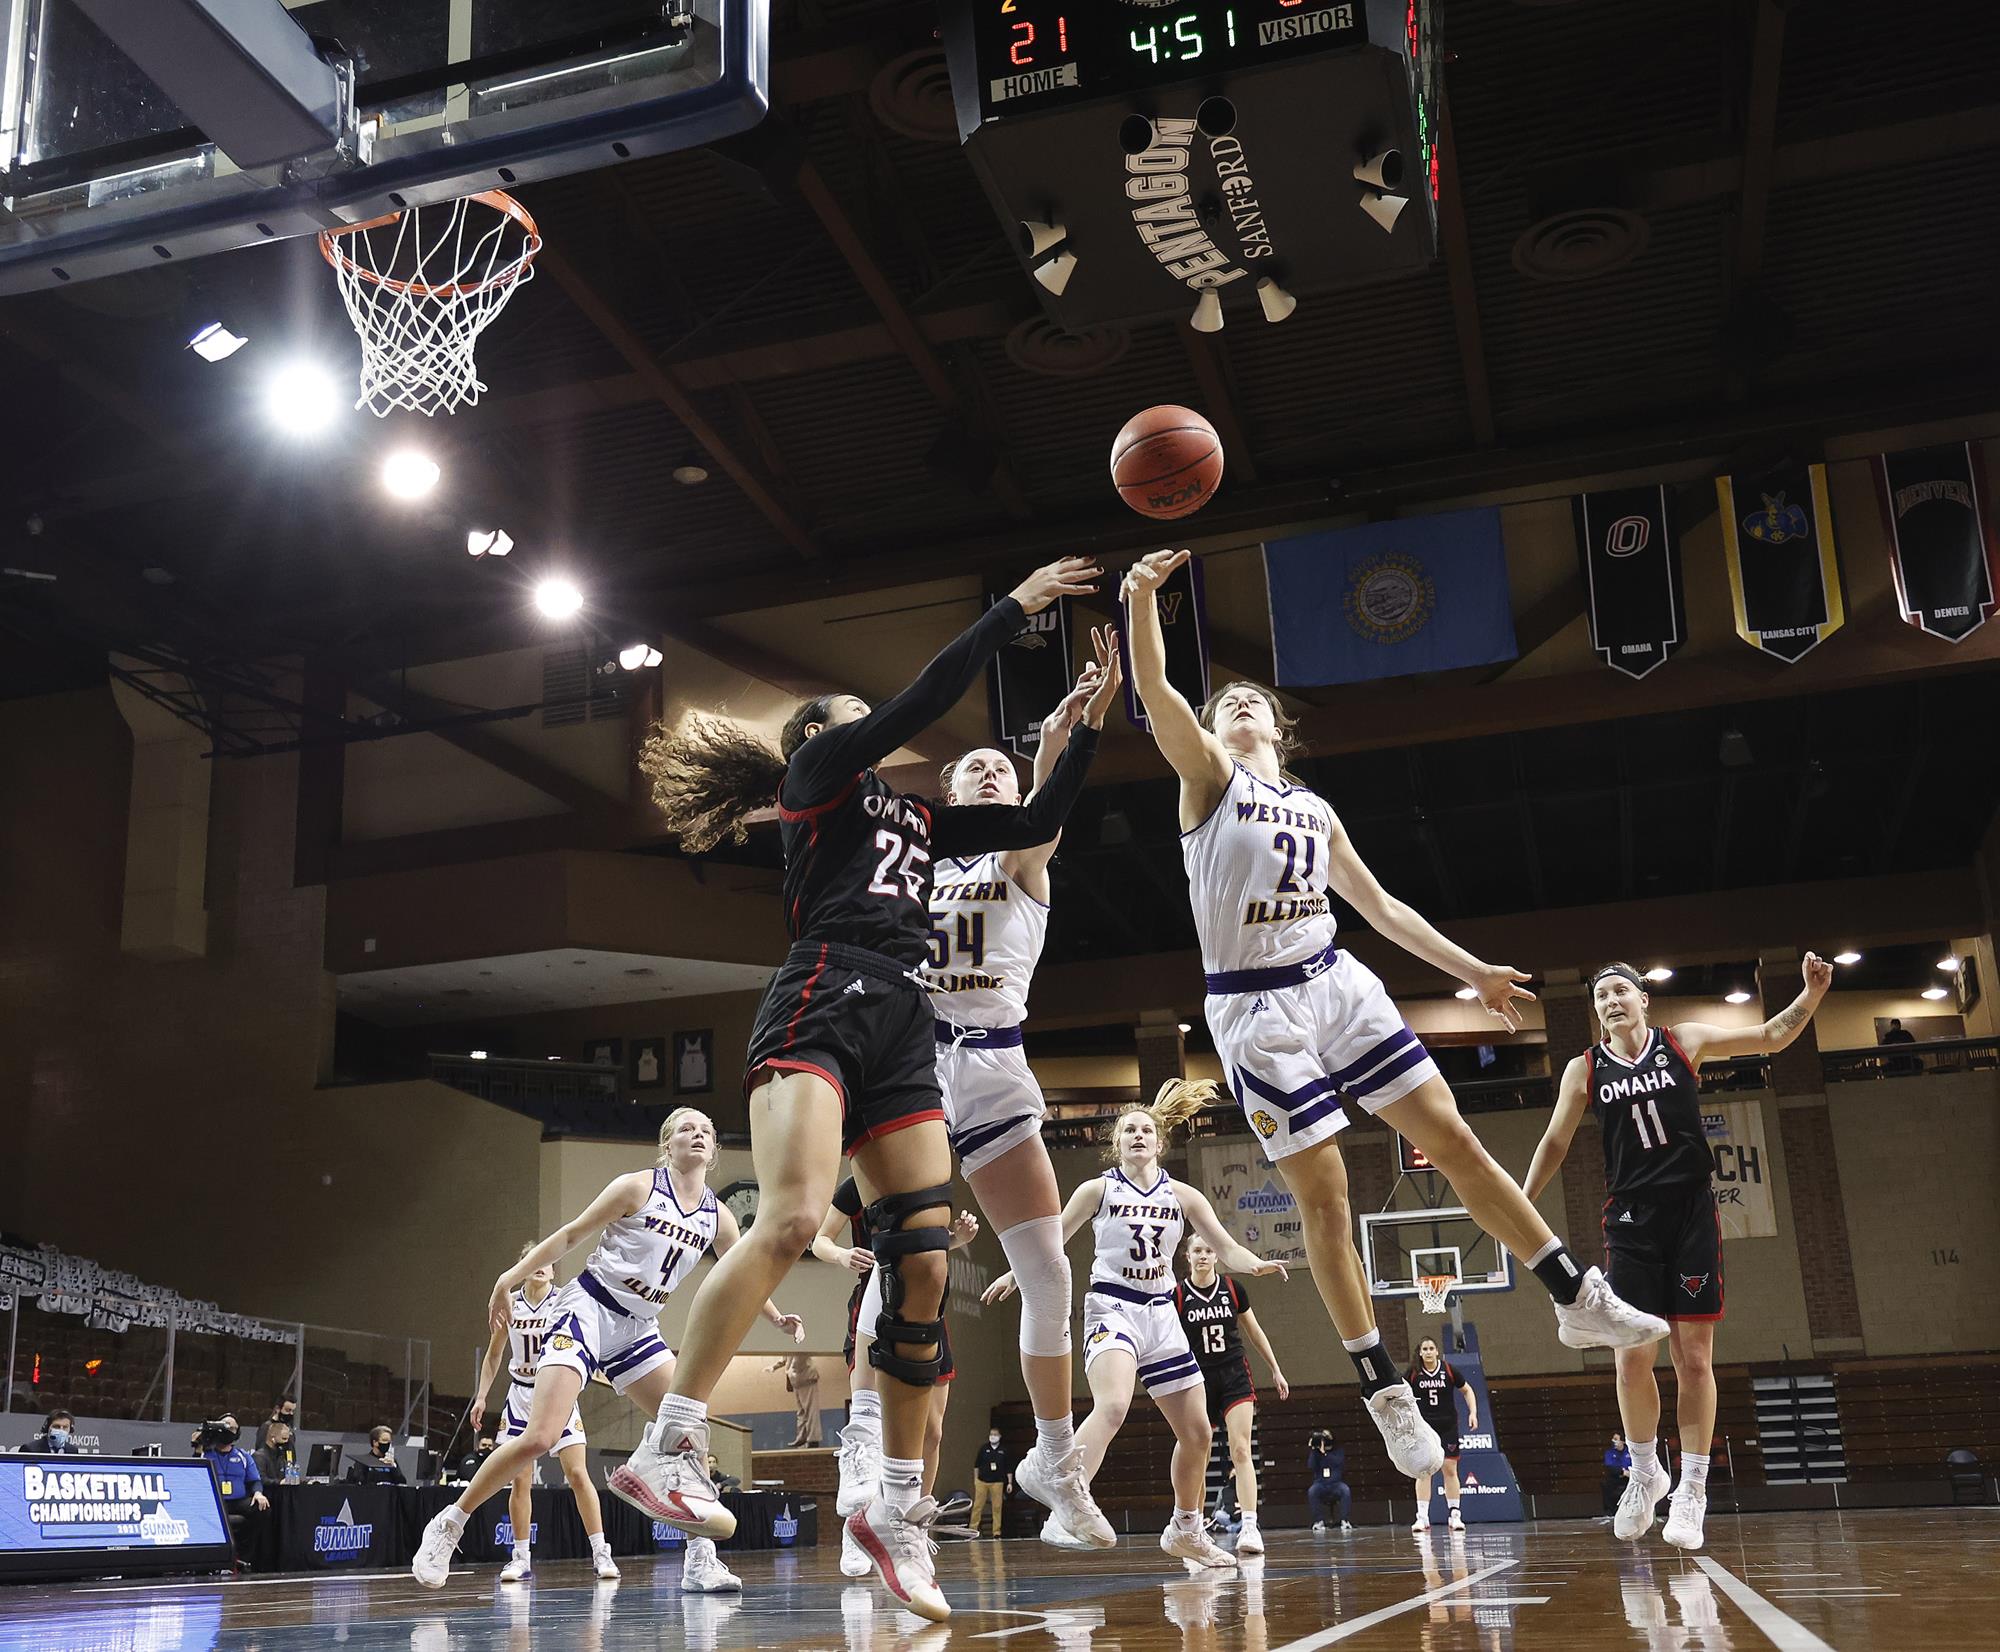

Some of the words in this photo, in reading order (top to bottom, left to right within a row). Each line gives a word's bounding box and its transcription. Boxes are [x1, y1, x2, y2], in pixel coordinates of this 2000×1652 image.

[1009, 16, 1068, 65] 21
[1130, 9, 1236, 64] 4:51
[1261, 9, 1352, 44] VISITOR
[1003, 67, 1065, 98] HOME
[1125, 117, 1247, 291] PENTAGON
[1211, 135, 1273, 258] SANFORD
[1014, 610, 1058, 636] RU
[1934, 606, 1969, 618] DENVER
[1762, 627, 1795, 639] KANSAS
[1797, 625, 1816, 636] CITY
[1621, 642, 1652, 654] OMAHA
[868, 829, 930, 906] 25
[1273, 831, 1316, 895] 21
[931, 880, 1008, 902] STERN
[928, 911, 986, 969] 54
[1600, 1069, 1677, 1104] OMAHA
[1631, 1100, 1669, 1149] 11
[1109, 1205, 1180, 1222] WESTERN
[1237, 1193, 1297, 1210] SUMMI
[643, 1216, 709, 1252] WESTERN
[1128, 1224, 1167, 1262] 33
[660, 1243, 684, 1287] 4
[1931, 1250, 1960, 1265] 114
[1187, 1305, 1233, 1323] OMAHA
[521, 1334, 544, 1363] 14
[1201, 1324, 1226, 1353] 13
[1419, 1380, 1446, 1389] OMAHA
[1428, 1390, 1439, 1406] 5
[66, 1434, 100, 1447] DAKOTA
[24, 1465, 170, 1501] BASKETBALL
[29, 1502, 142, 1523] CHAMPIONSHIPS
[142, 1521, 187, 1536] SUMMIT
[314, 1524, 373, 1552] SUMMIT
